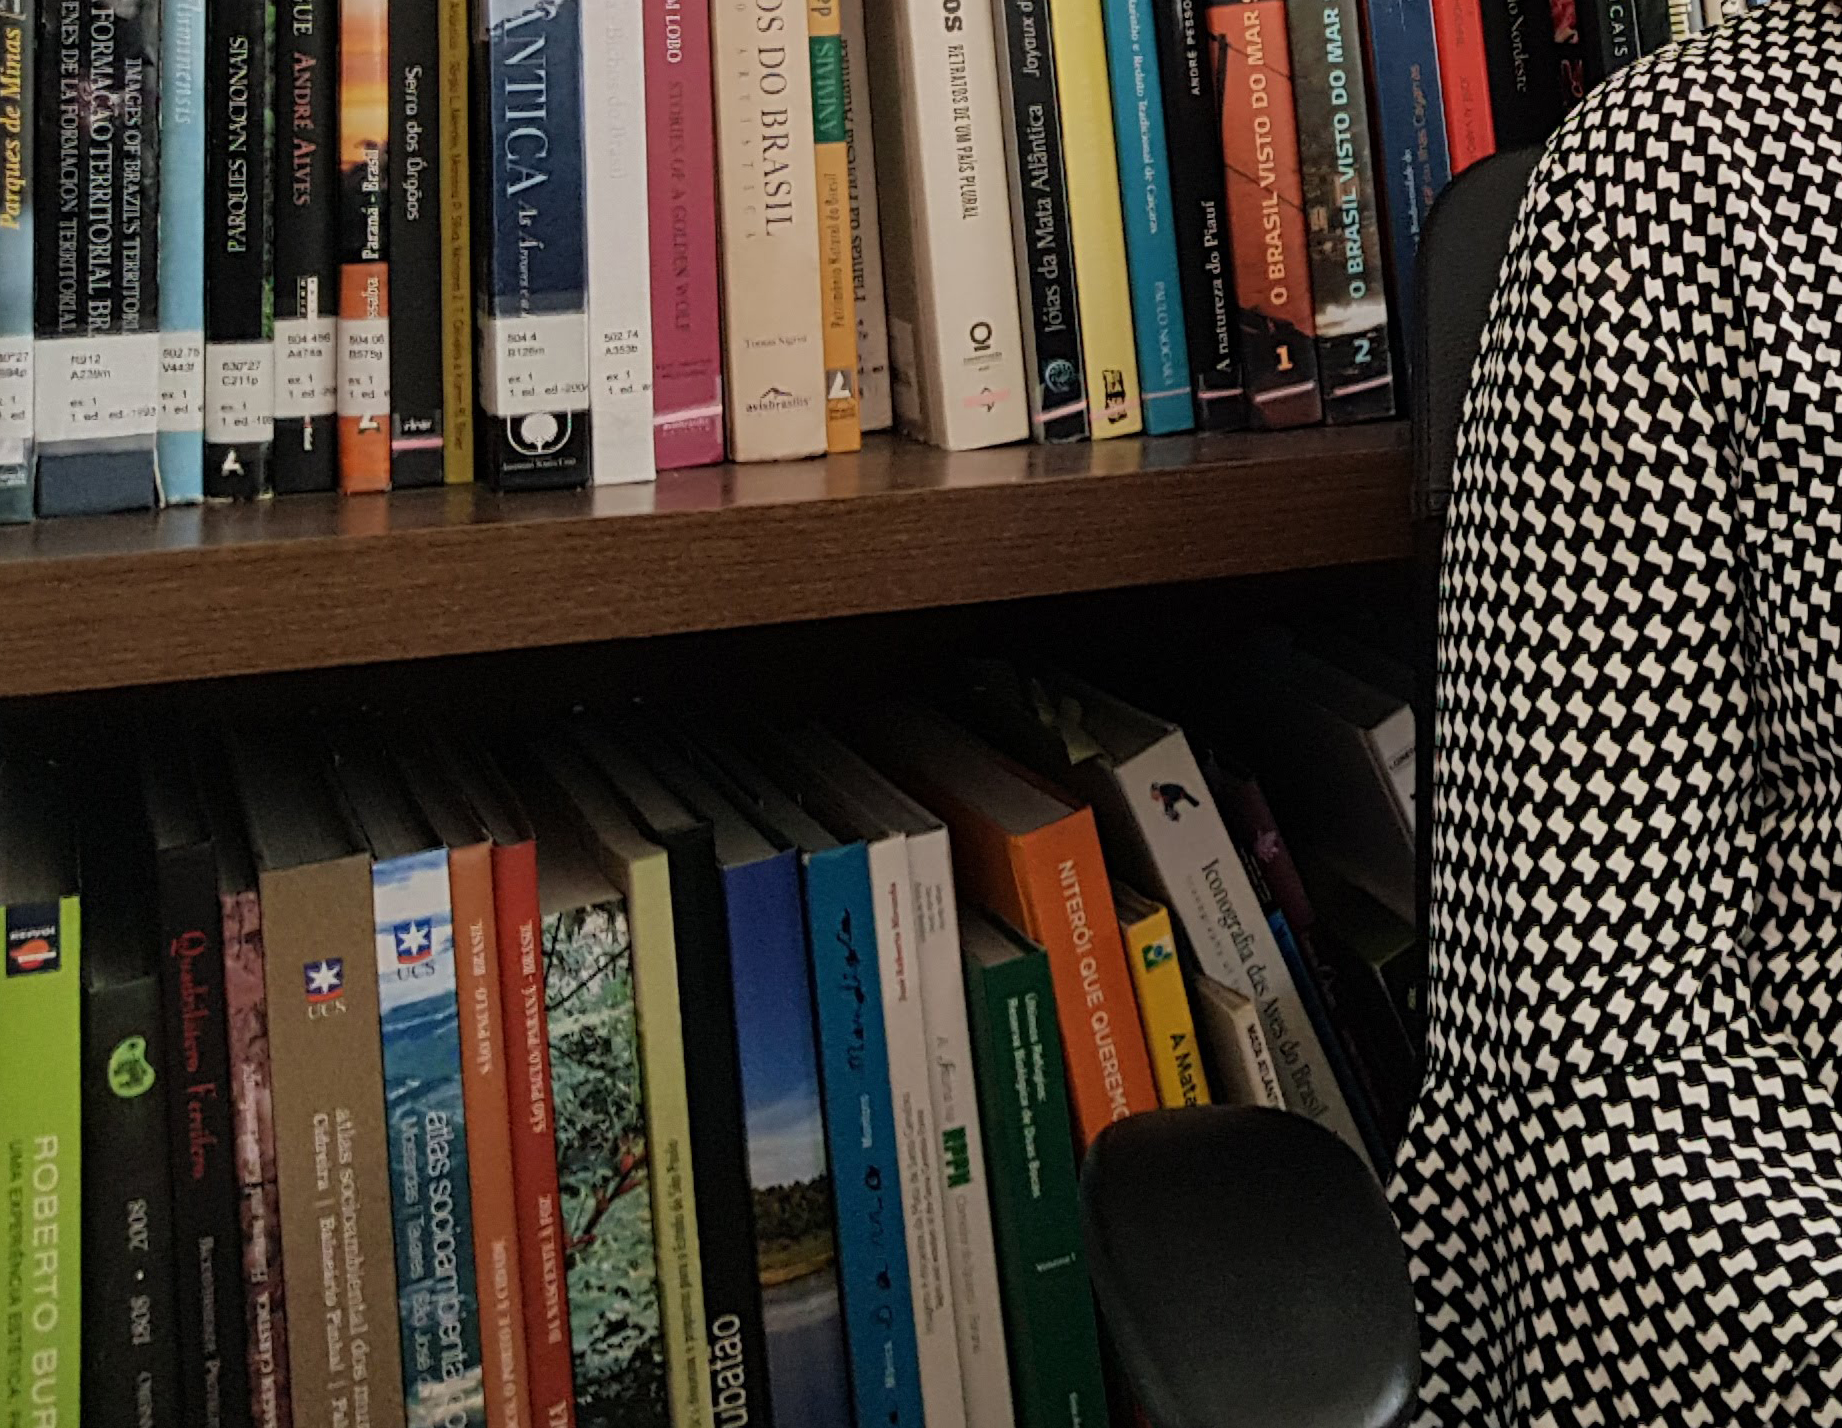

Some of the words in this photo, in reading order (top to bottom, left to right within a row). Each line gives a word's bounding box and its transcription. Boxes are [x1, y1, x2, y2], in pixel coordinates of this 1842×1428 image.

[0, 27, 23, 89] Minas
[61, 49, 80, 74] DE
[665, 10, 683, 64] LOBO
[1018, 18, 1041, 77] Joyaux
[1243, 9, 1264, 66] MAR
[1322, 6, 1344, 64] MAR
[227, 34, 250, 152] NACIONAIS
[756, 47, 788, 96] DO
[814, 41, 841, 137] ANIMAIS
[947, 44, 967, 105] RETRATOS
[1249, 73, 1269, 110] DO
[1329, 70, 1347, 107] DO
[0, 94, 22, 132] de
[123, 128, 141, 153] OF
[666, 79, 685, 154] STORIES
[953, 107, 970, 122] DE
[292, 141, 319, 207] ALVES
[360, 148, 380, 193] Brasil
[670, 157, 687, 181] OF
[759, 108, 794, 238] BRASIL
[1024, 103, 1051, 189] Atlântica
[1254, 115, 1277, 189] VISTO
[1332, 112, 1355, 183] VISTO
[0, 136, 22, 230] Parques
[227, 155, 248, 254] PARQUES
[88, 142, 115, 294] TERRITORIAL
[360, 206, 380, 261] Paraná
[671, 204, 689, 279] GOLDEN
[1034, 192, 1054, 251] Mata
[1200, 200, 1220, 248] Piauí
[1259, 191, 1286, 281] BRASIL
[1339, 187, 1367, 276] BRASIL
[1037, 254, 1058, 280] da
[1203, 250, 1222, 275] do
[1348, 280, 1367, 299] O
[674, 284, 692, 333] WOLF
[1206, 278, 1230, 355] natureza
[1269, 287, 1289, 306] O
[1215, 357, 1232, 373] A
[1275, 345, 1294, 373] 1
[1353, 337, 1372, 365] 2
[1056, 858, 1097, 951] NITERÓI
[397, 960, 435, 982] UCS
[1075, 954, 1105, 1010] QUE
[1201, 858, 1255, 961] Iconografia
[1246, 961, 1272, 998] das
[1278, 1042, 1300, 1066] do
[1290, 1064, 1327, 1117] Brasil
[307, 999, 347, 1020] UCS
[1168, 1032, 1186, 1050] A
[425, 1110, 452, 1178] atlas
[32, 1134, 59, 1333] ROBERTO
[334, 1107, 353, 1165] atlas
[350, 1338, 368, 1382] dos
[428, 1178, 467, 1381] socioambienta
